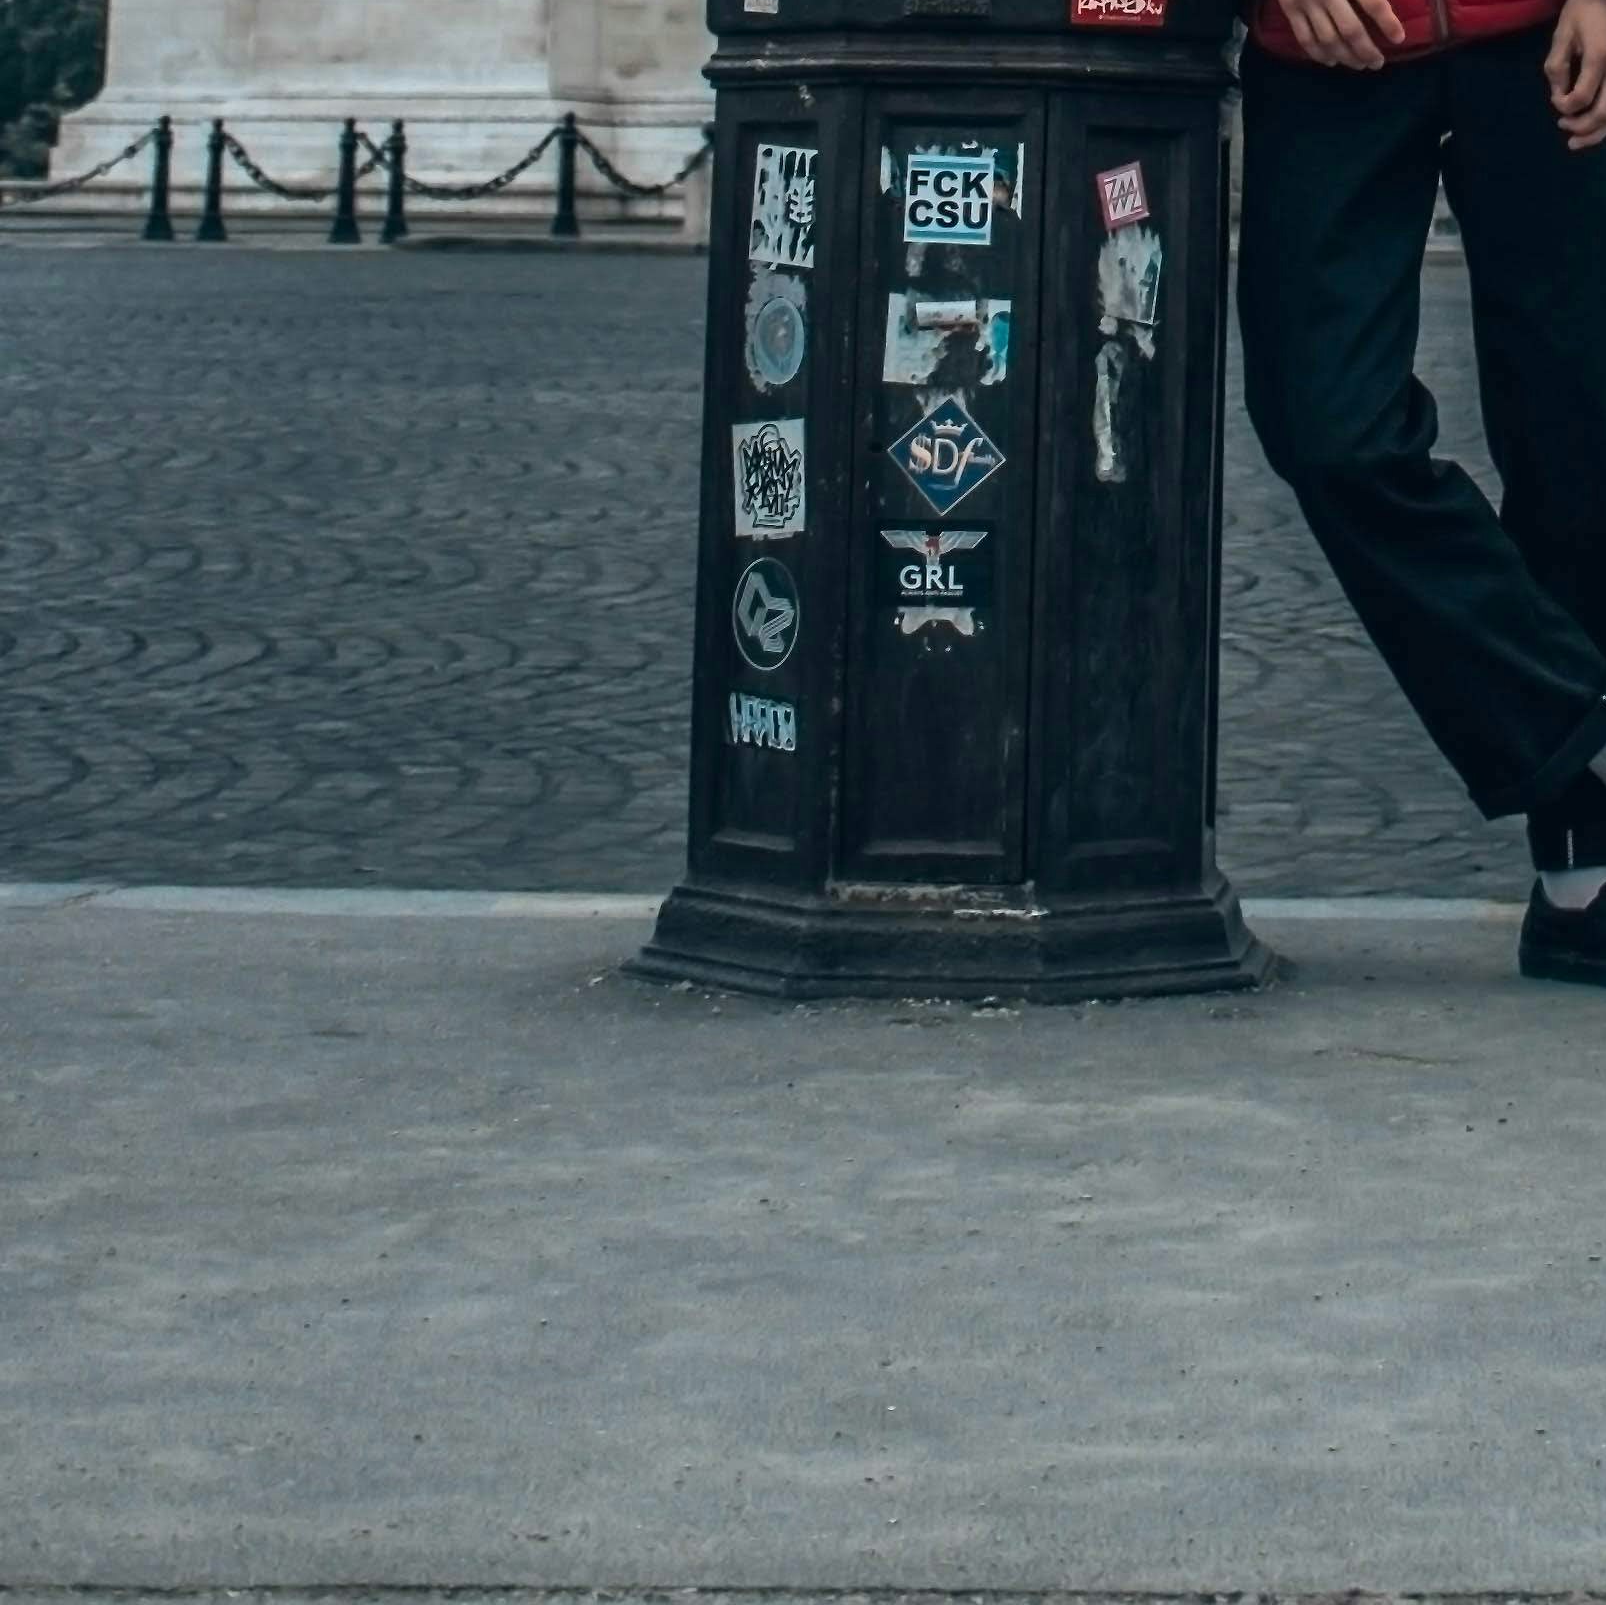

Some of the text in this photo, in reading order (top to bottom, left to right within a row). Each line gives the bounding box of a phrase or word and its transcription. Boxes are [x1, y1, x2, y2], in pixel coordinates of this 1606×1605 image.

[909, 170, 989, 198] FCK
[908, 199, 989, 229] CSU
[900, 564, 964, 589] GRL
